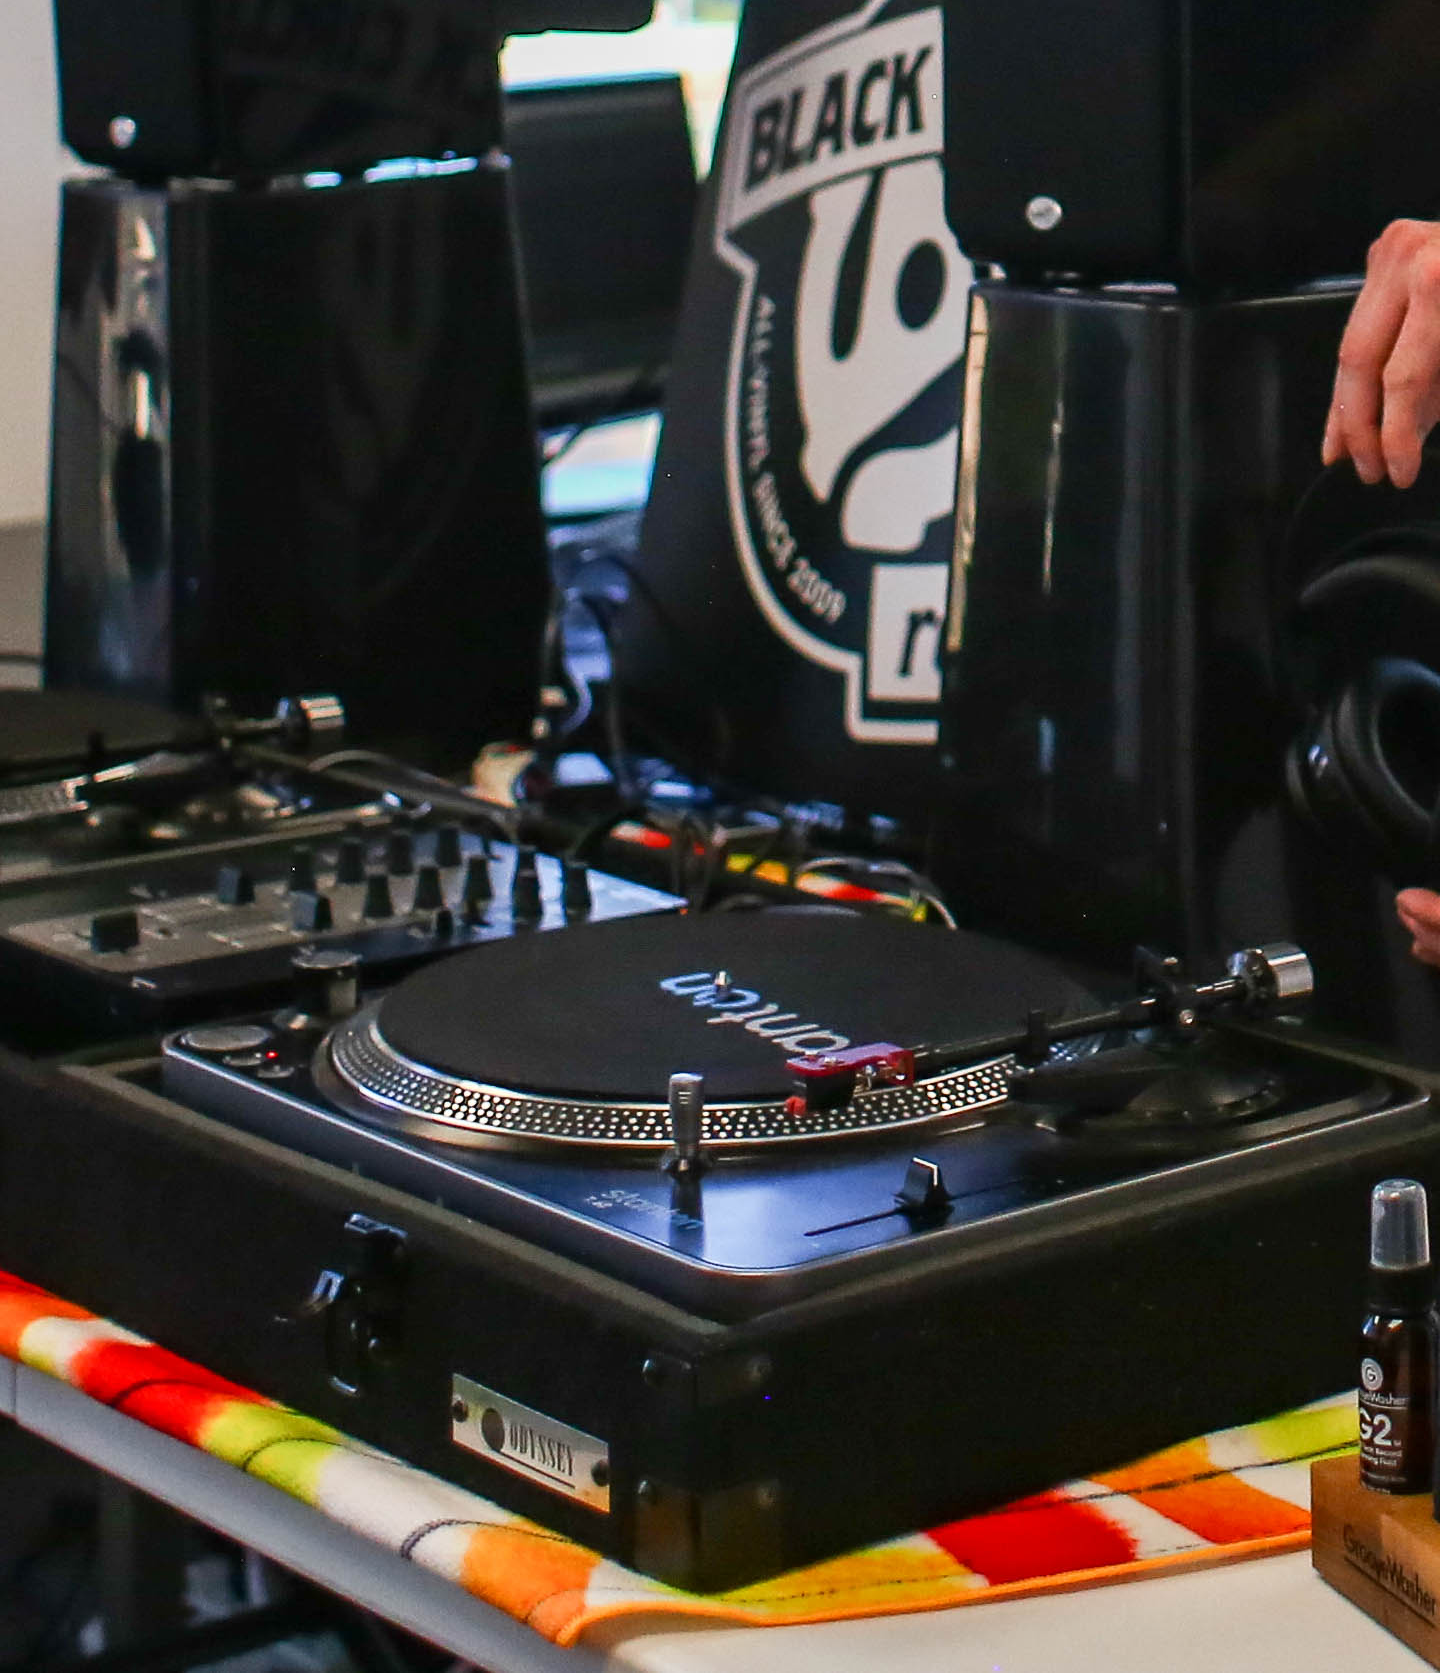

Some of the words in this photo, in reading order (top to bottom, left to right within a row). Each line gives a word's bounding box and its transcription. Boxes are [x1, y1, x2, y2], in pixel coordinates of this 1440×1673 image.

[743, 44, 934, 194] BLACK
[787, 557, 847, 623] 2009
[509, 1422, 574, 1477] ODYSSEY
